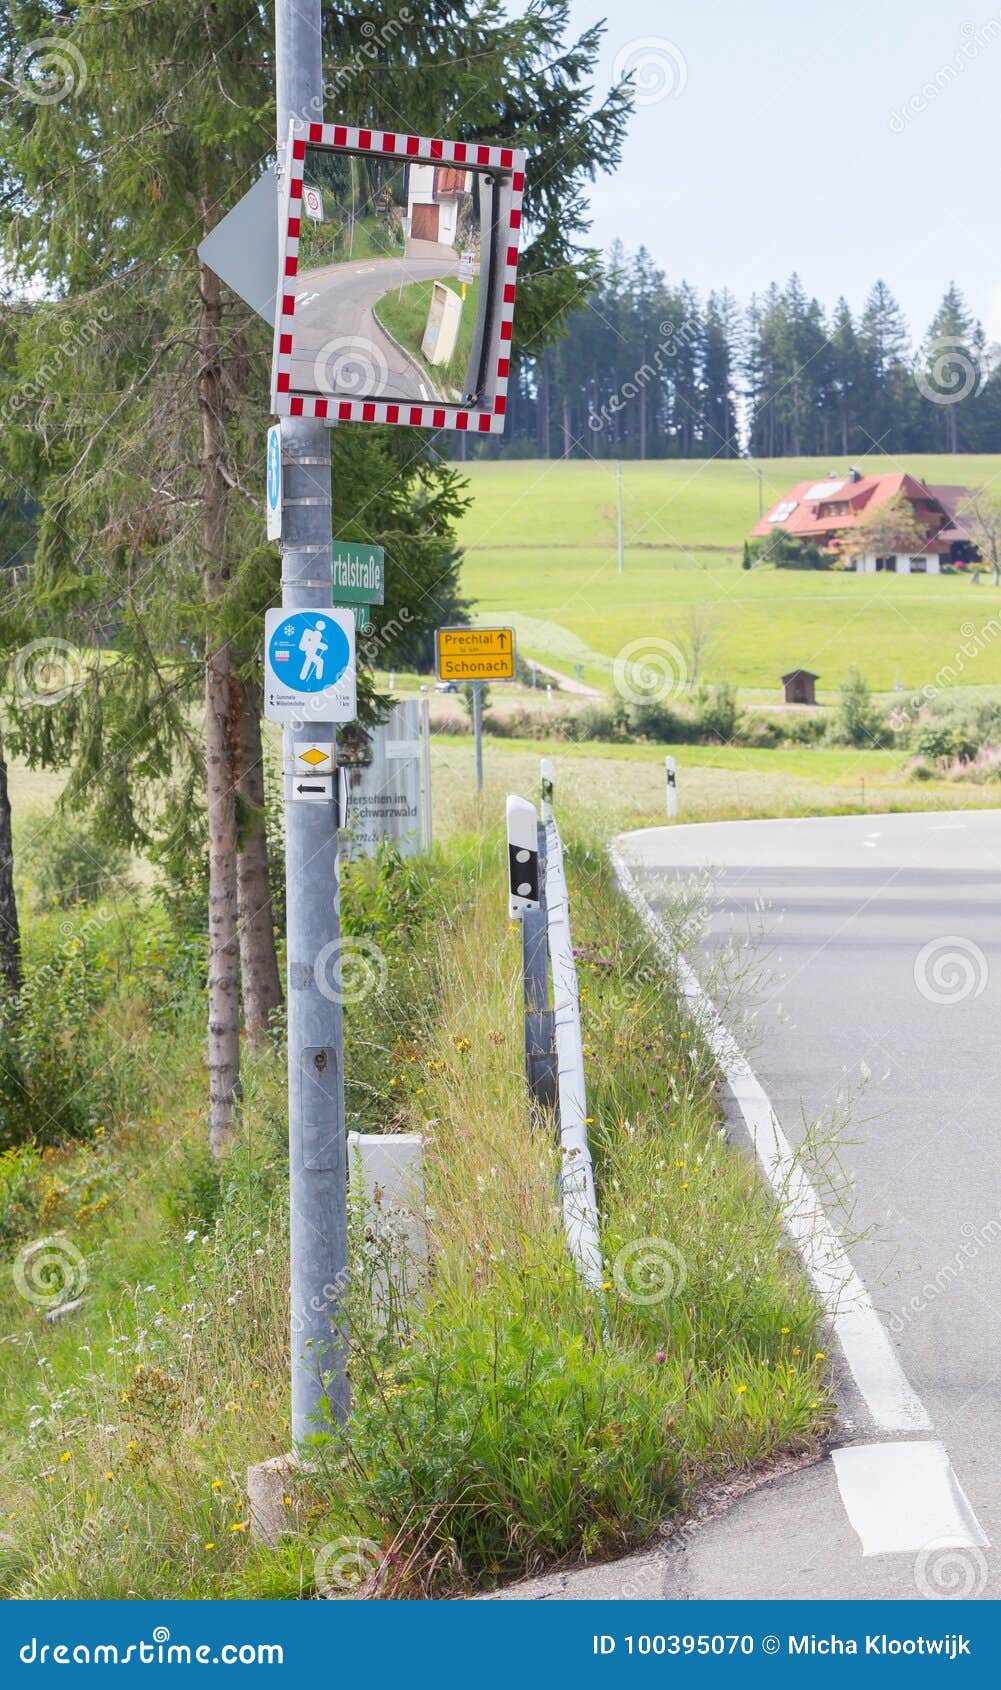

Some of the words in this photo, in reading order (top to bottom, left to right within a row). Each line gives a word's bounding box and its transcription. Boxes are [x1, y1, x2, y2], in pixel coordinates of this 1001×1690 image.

[332, 553, 380, 589] rtalstraße
[445, 634, 493, 644] Prechtal
[446, 660, 508, 672] Schonach
[353, 807, 417, 818] Schwarzwald
